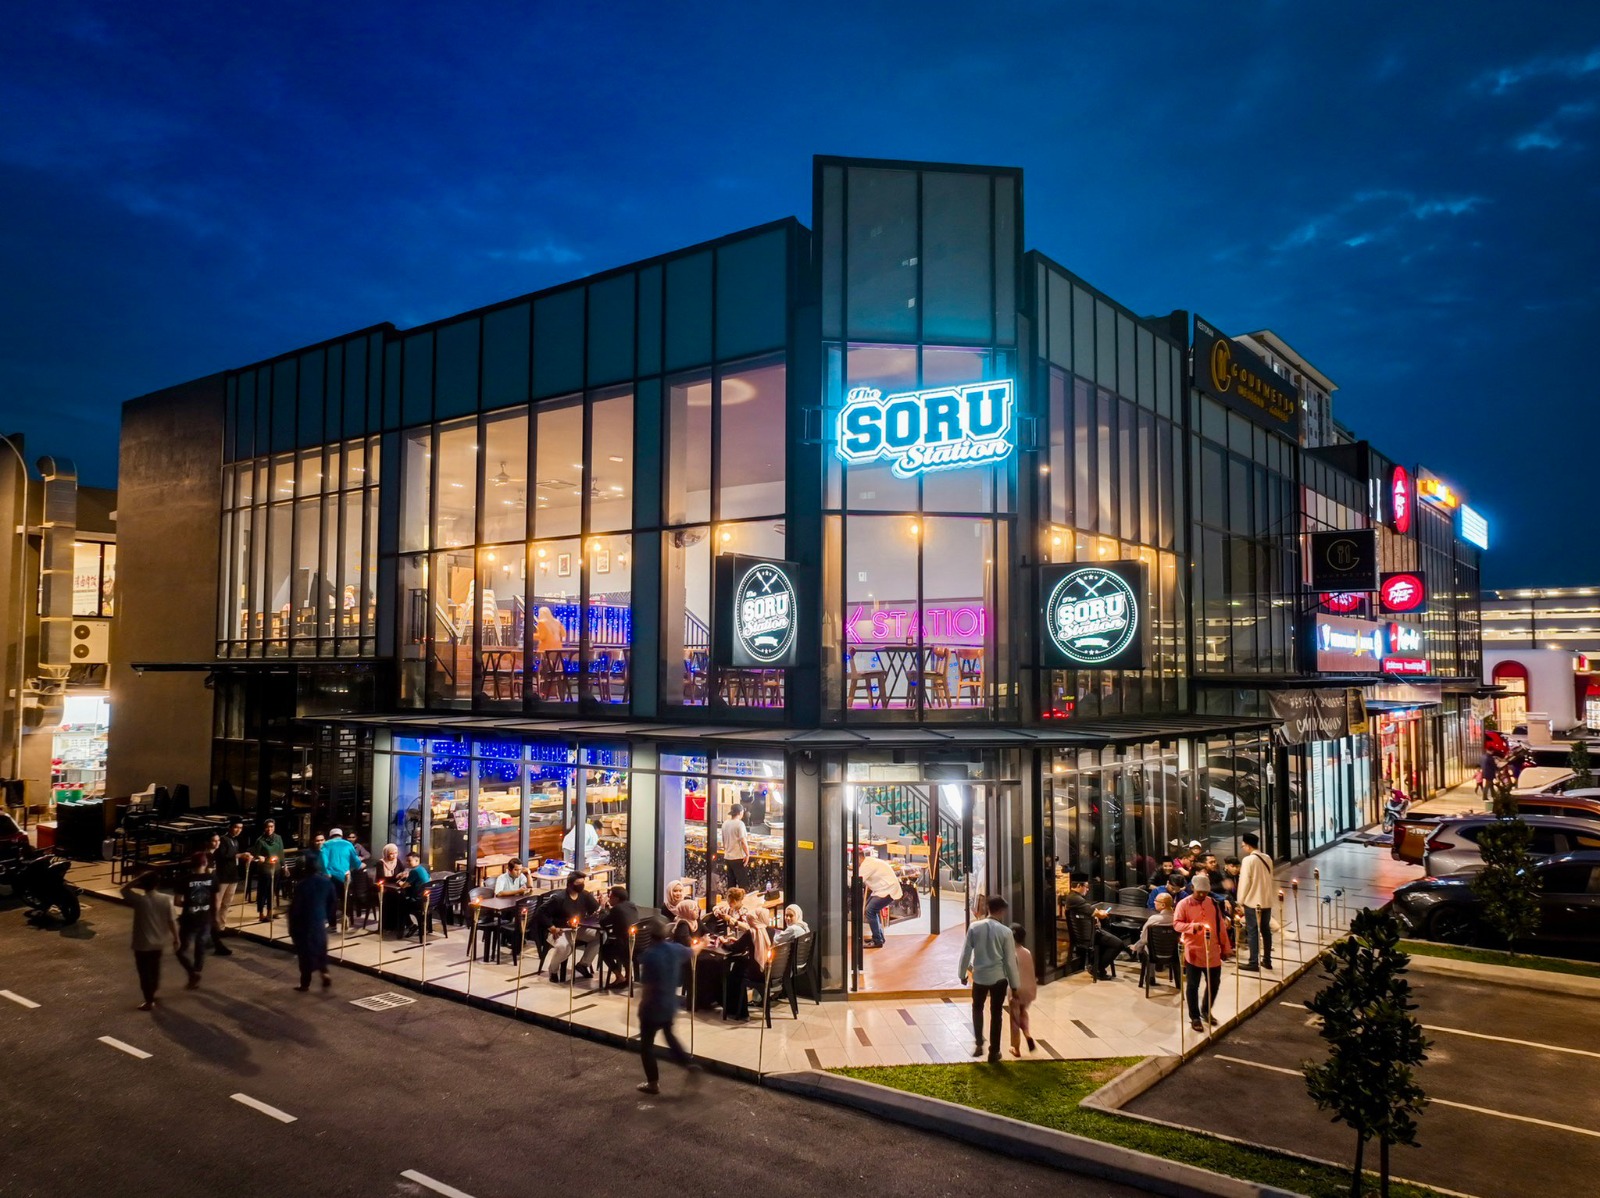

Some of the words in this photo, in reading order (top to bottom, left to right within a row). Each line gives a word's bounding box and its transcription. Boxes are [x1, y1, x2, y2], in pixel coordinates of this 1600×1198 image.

[849, 387, 880, 401] The
[842, 384, 1010, 457] SORU
[899, 438, 1010, 469] Station
[743, 594, 788, 622] SORU
[1059, 594, 1125, 626] SORU
[743, 616, 788, 638] Station
[1059, 618, 1125, 640] Station
